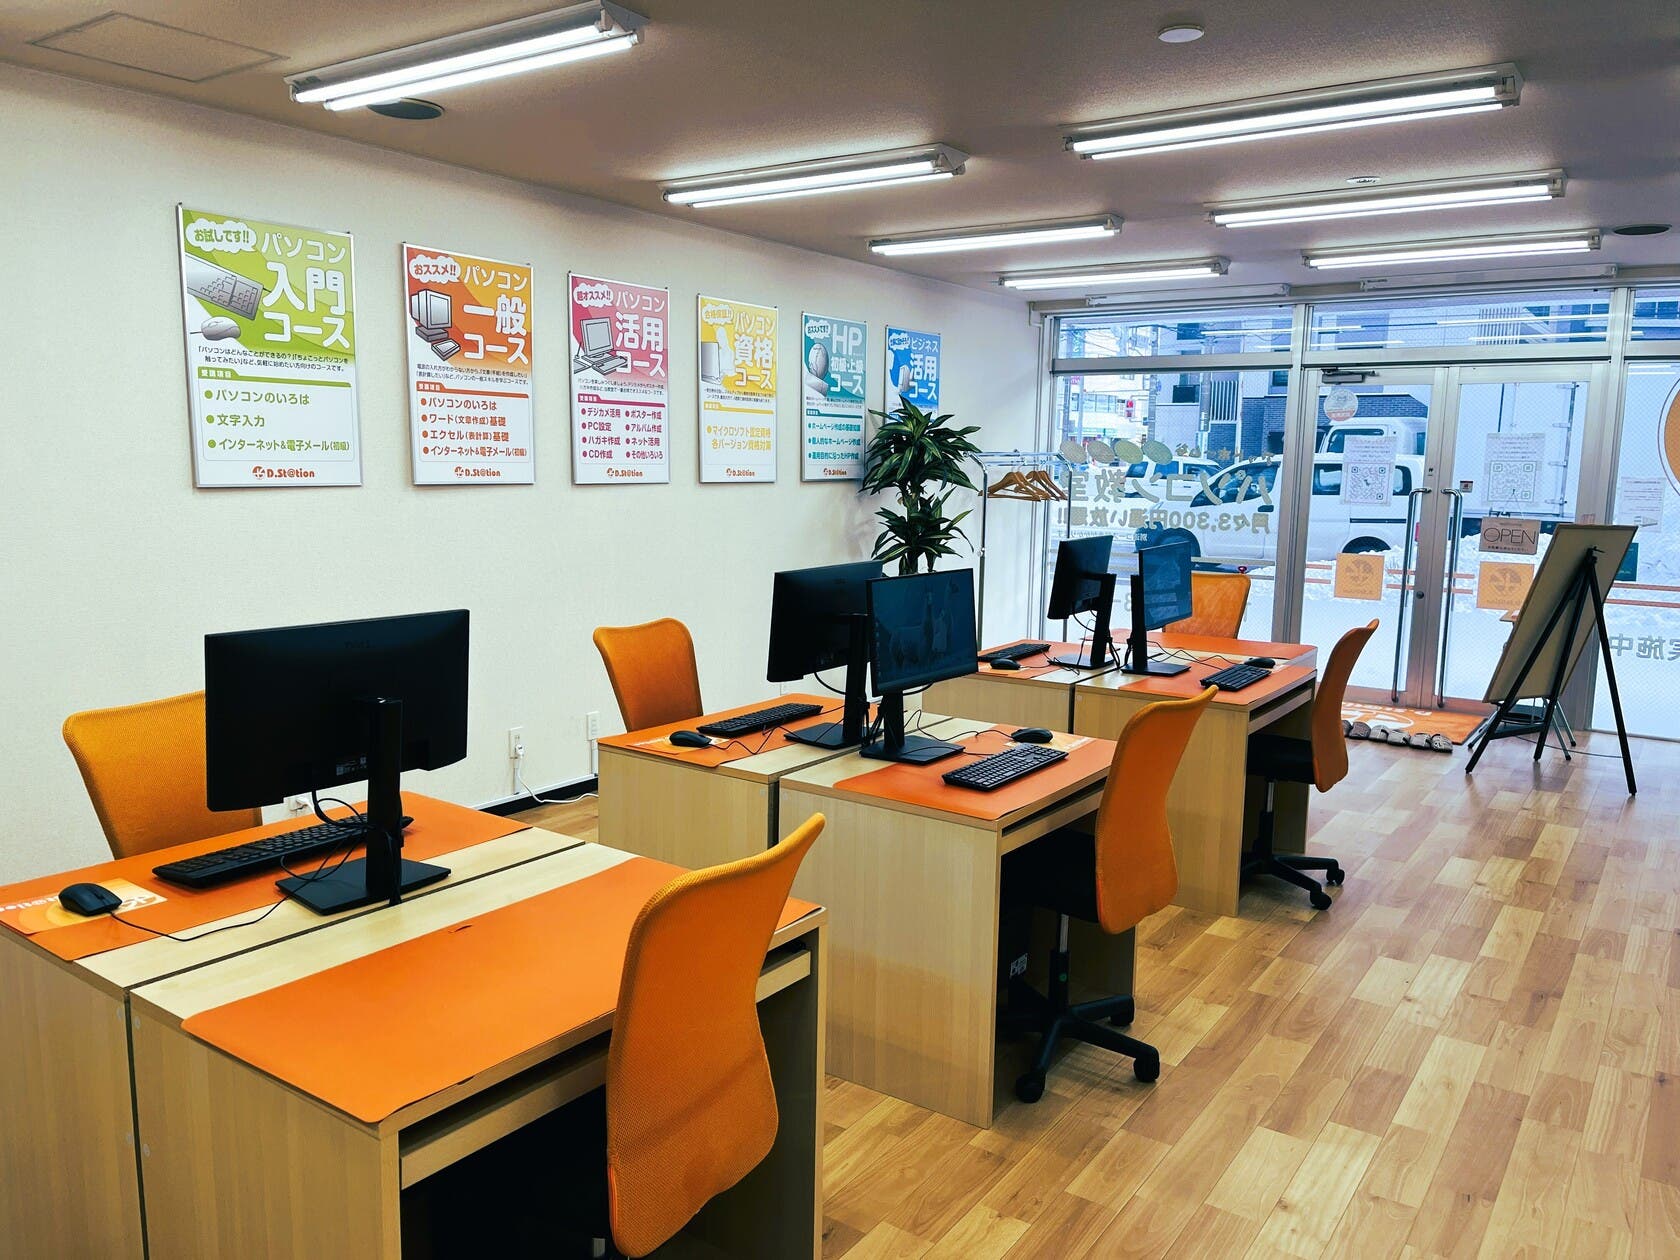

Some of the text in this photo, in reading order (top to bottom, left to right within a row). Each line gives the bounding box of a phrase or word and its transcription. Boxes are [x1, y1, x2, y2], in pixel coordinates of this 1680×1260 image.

[194, 228, 250, 244] お試しです!!
[262, 232, 346, 264] パソコン
[414, 264, 456, 276] おススメ!!
[464, 266, 528, 291] パソコン
[262, 260, 346, 316] 入門
[616, 291, 665, 312] パソコン
[463, 294, 527, 336] 一般
[734, 312, 776, 336] パソコン
[263, 311, 350, 349] コース
[616, 312, 664, 352] 活用
[832, 324, 862, 355] HP
[464, 333, 529, 364] コース
[734, 334, 773, 368] 資格
[910, 337, 938, 352] ビジネス
[616, 351, 666, 378] コース
[910, 354, 937, 382] 活用
[735, 368, 772, 388] コース
[830, 373, 864, 394] コース
[216, 388, 310, 405] パソコンのいろは
[909, 382, 937, 400] コース
[428, 398, 497, 410] パソコンのいろは
[588, 408, 621, 418] デジカメ活用
[216, 414, 265, 428] 文字入力
[588, 436, 621, 446] ハガキ作成
[588, 450, 613, 459] CD作成
[1484, 528, 1536, 544] OPEN
